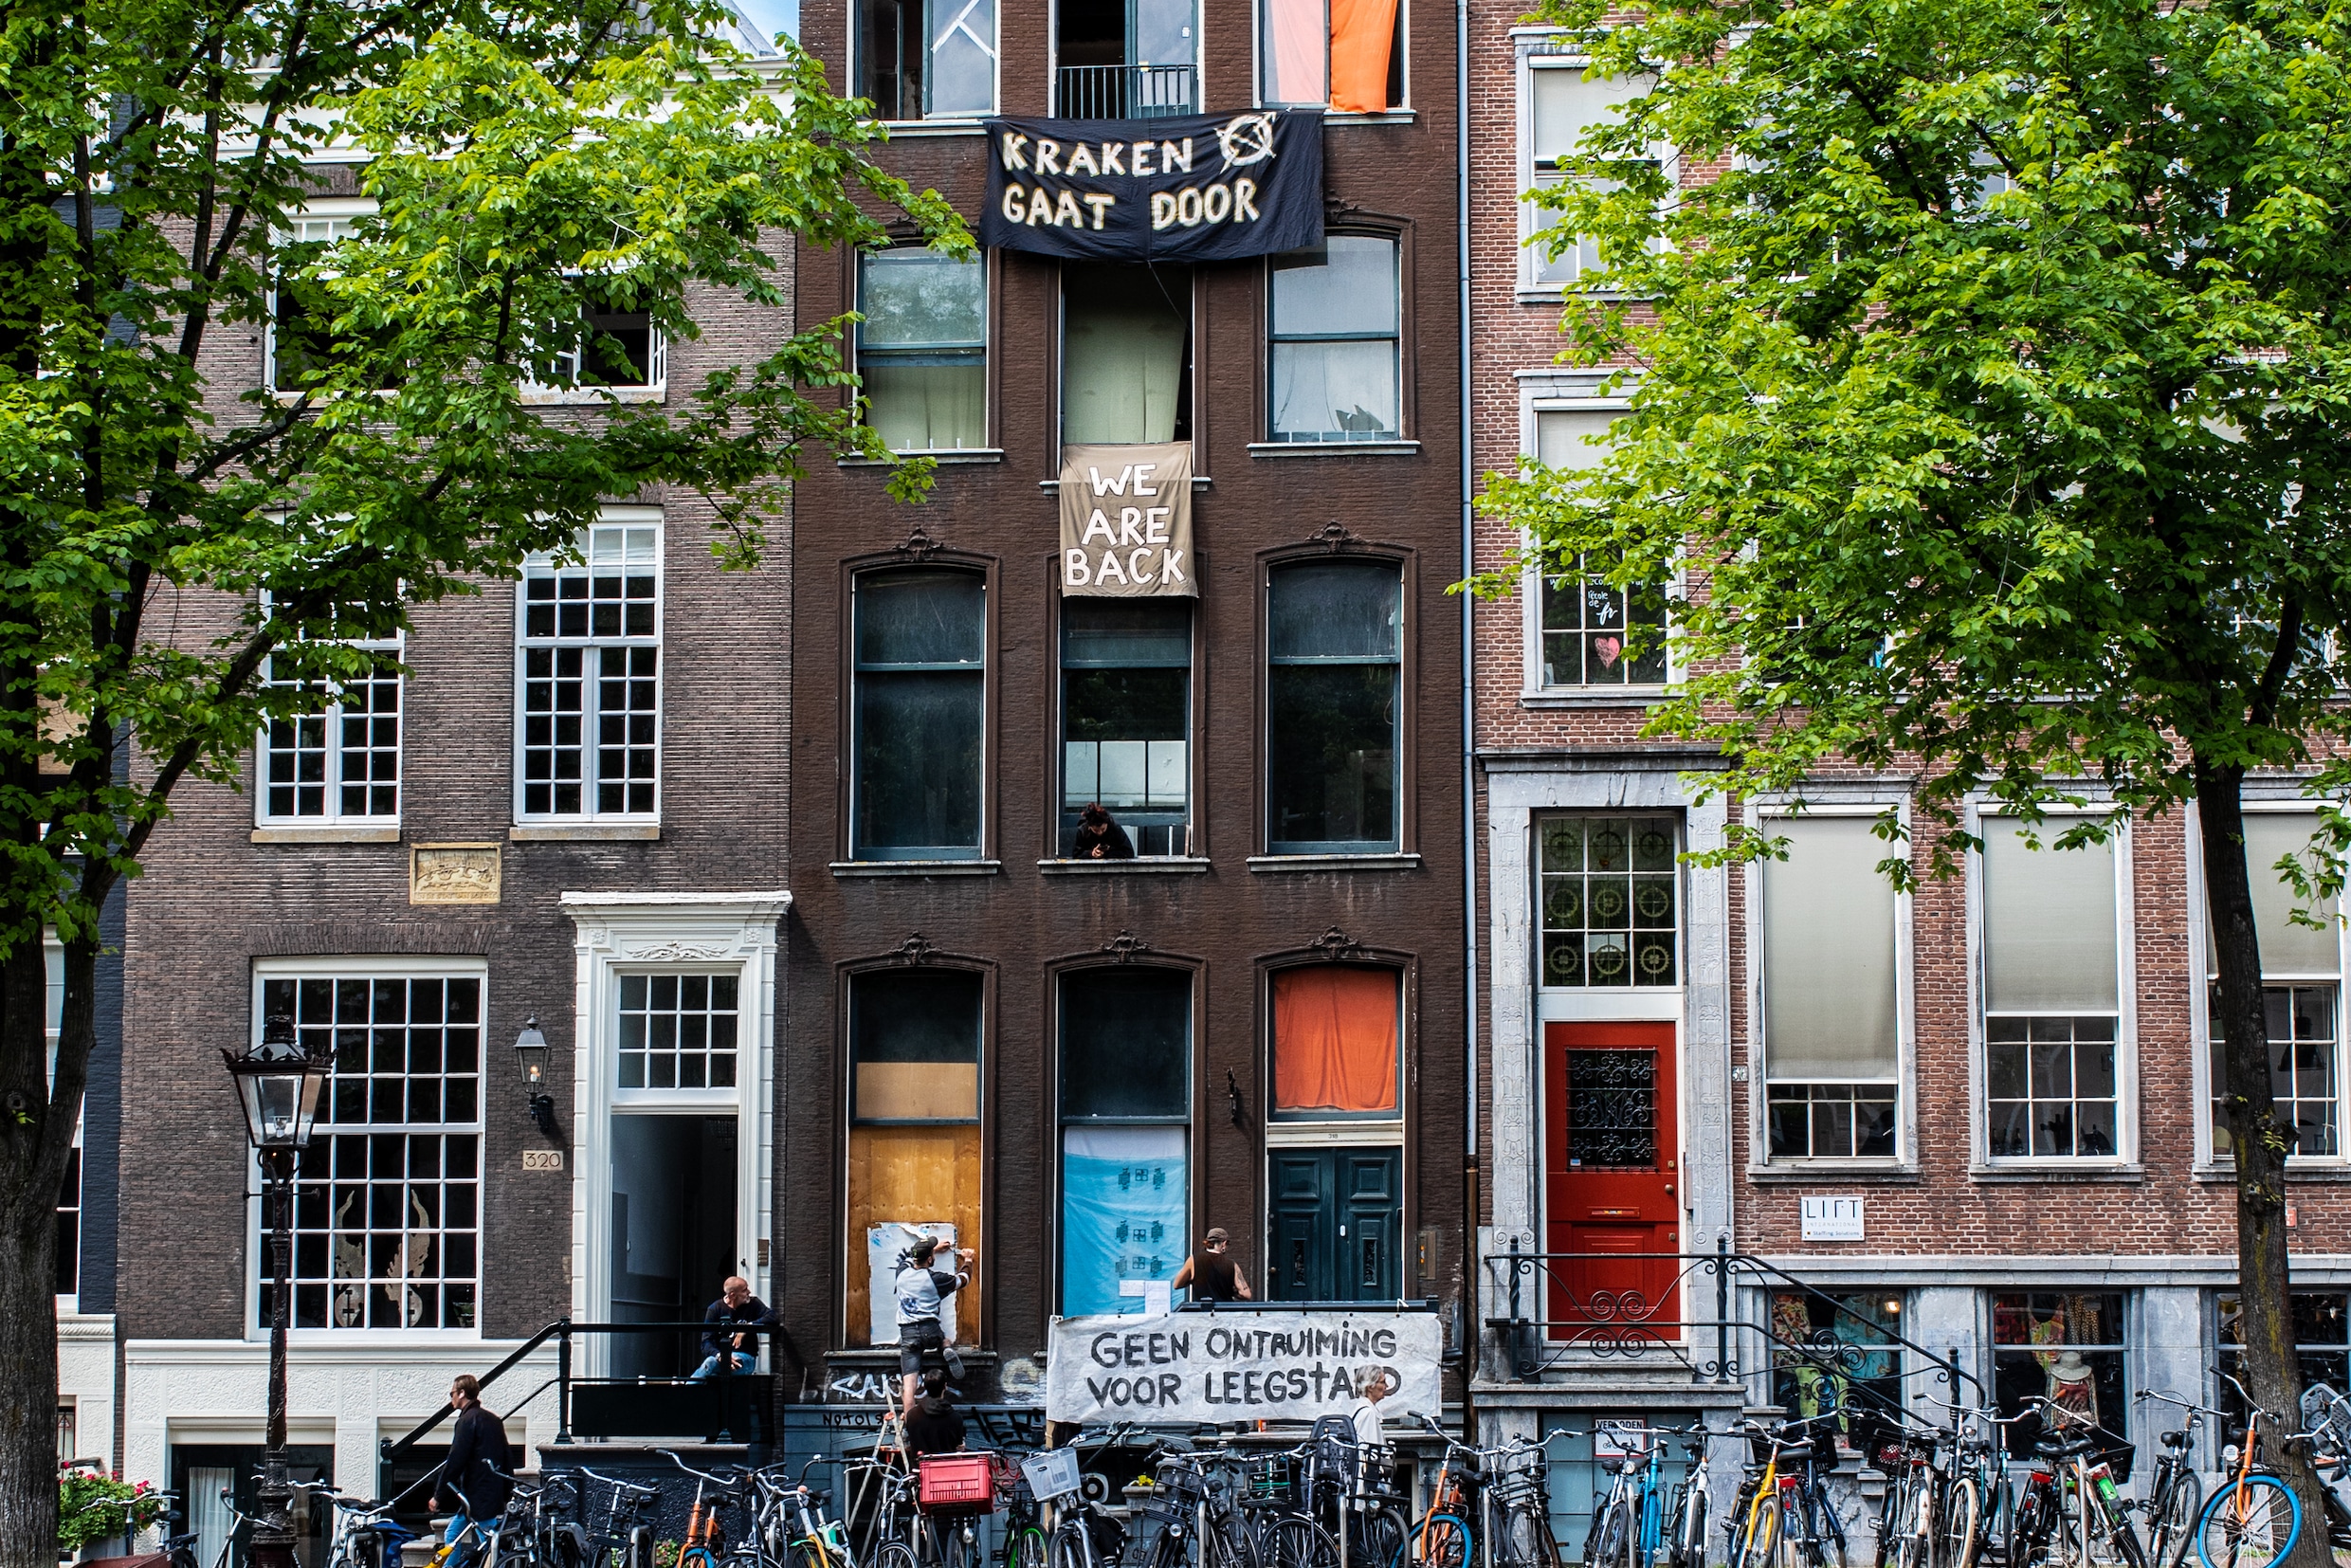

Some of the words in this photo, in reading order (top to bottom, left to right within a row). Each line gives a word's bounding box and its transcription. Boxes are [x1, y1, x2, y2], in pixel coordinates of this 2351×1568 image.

[1002, 132, 1194, 177] KRAKEN
[1001, 182, 1116, 230] GAAT
[1151, 177, 1261, 230] DOOR
[1088, 463, 1157, 497] WE
[1081, 506, 1171, 546] ARE
[1066, 547, 1186, 586] BACK
[1589, 599, 1600, 608] de
[525, 1152, 561, 1167] 320
[1806, 1200, 1859, 1218] LIFT
[1090, 1331, 1190, 1368] GEEN
[1086, 1373, 1182, 1409] VOOR
[1596, 1420, 1643, 1430] VERODEN
